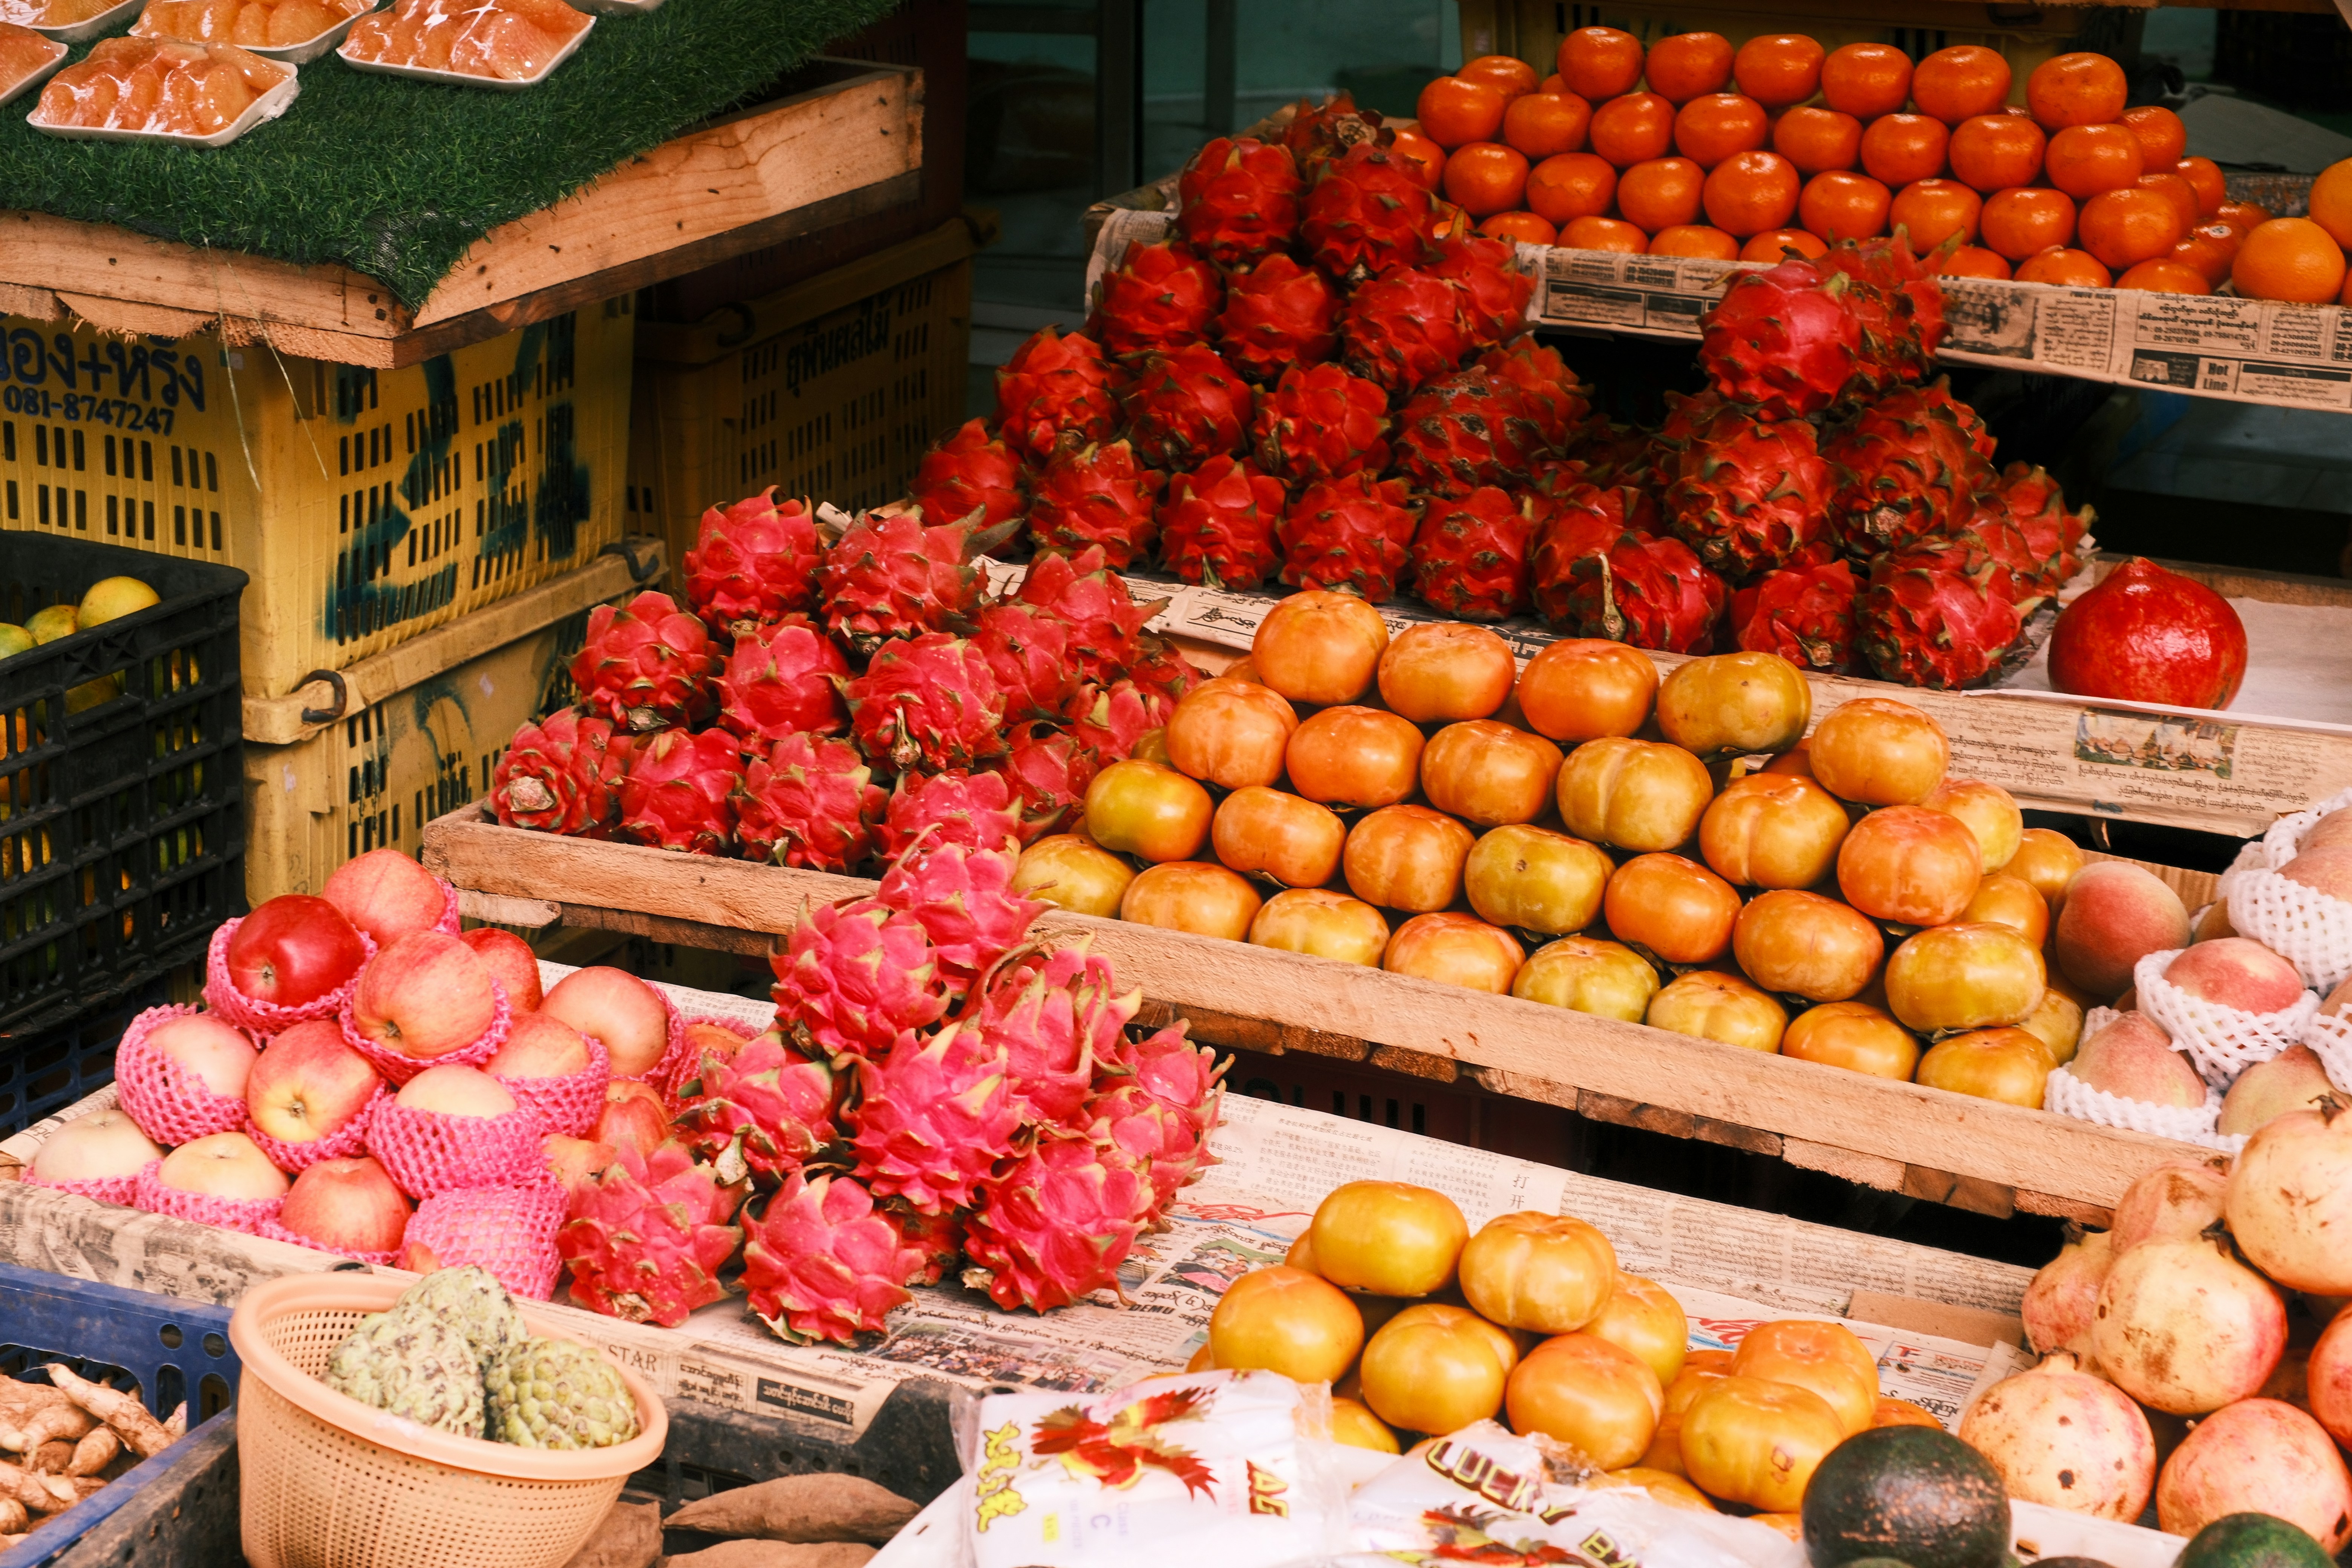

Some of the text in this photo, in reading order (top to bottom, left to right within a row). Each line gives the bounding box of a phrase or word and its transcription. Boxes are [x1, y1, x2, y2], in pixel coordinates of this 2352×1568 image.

[2208, 363, 2229, 375] Hot
[2203, 378, 2228, 391] Line
[4, 385, 175, 436] 081-8747247
[1128, 1304, 1176, 1314] DEMU
[608, 1344, 657, 1372] STAR
[1426, 1440, 1577, 1526] LUCKY
[1090, 1514, 1112, 1530] C
